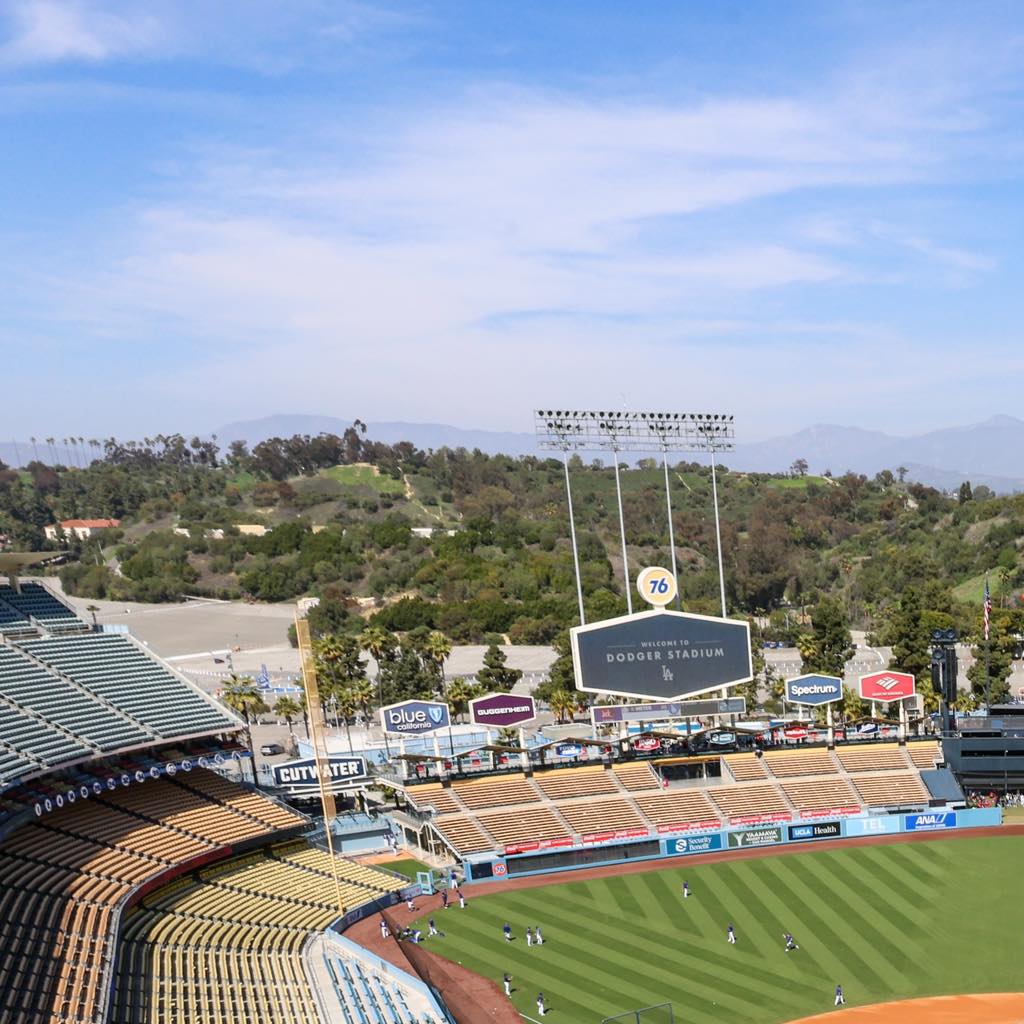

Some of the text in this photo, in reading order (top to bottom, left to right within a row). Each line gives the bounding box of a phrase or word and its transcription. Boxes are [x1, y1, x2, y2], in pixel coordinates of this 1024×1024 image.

[650, 578, 668, 594] 76
[607, 648, 724, 662] DODGER STADIUM
[792, 684, 834, 696] Spectrum
[478, 706, 530, 716] GUGGENHEIM
[390, 710, 426, 724] blue
[397, 722, 432, 731] california
[280, 761, 359, 782] CUTWATER
[916, 815, 935, 824] ANA
[814, 826, 837, 835] Health
[688, 836, 712, 844] Security
